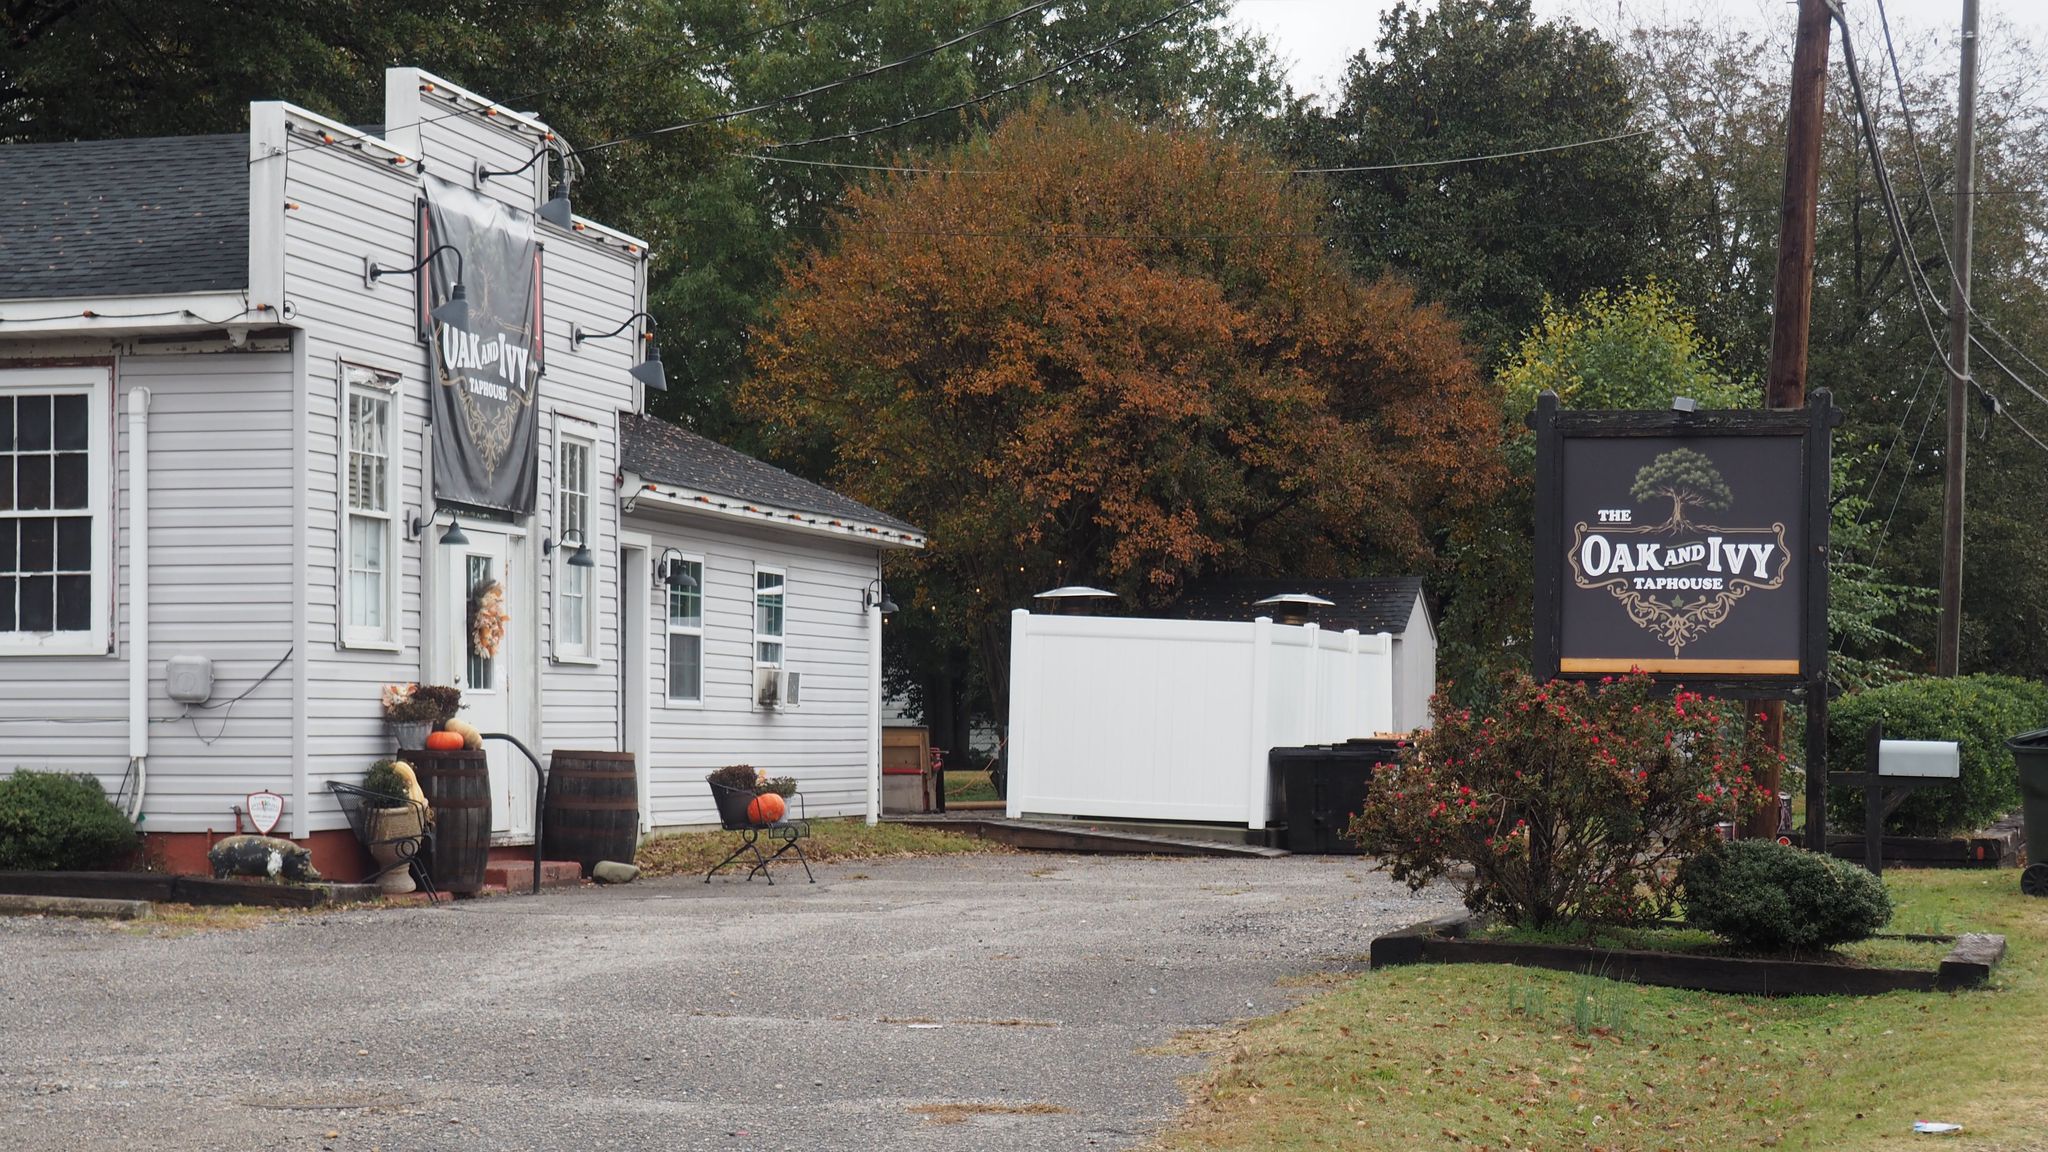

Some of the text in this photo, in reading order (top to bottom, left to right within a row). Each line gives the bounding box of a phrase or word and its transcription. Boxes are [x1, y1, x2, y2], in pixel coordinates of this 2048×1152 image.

[443, 322, 529, 392] OAK AND IVY
[469, 377, 508, 401] TAPHOUSE
[1598, 509, 1632, 522] THE
[1581, 534, 1775, 579] OAK AND IVY
[1633, 577, 1723, 590] TAPHOUSE
